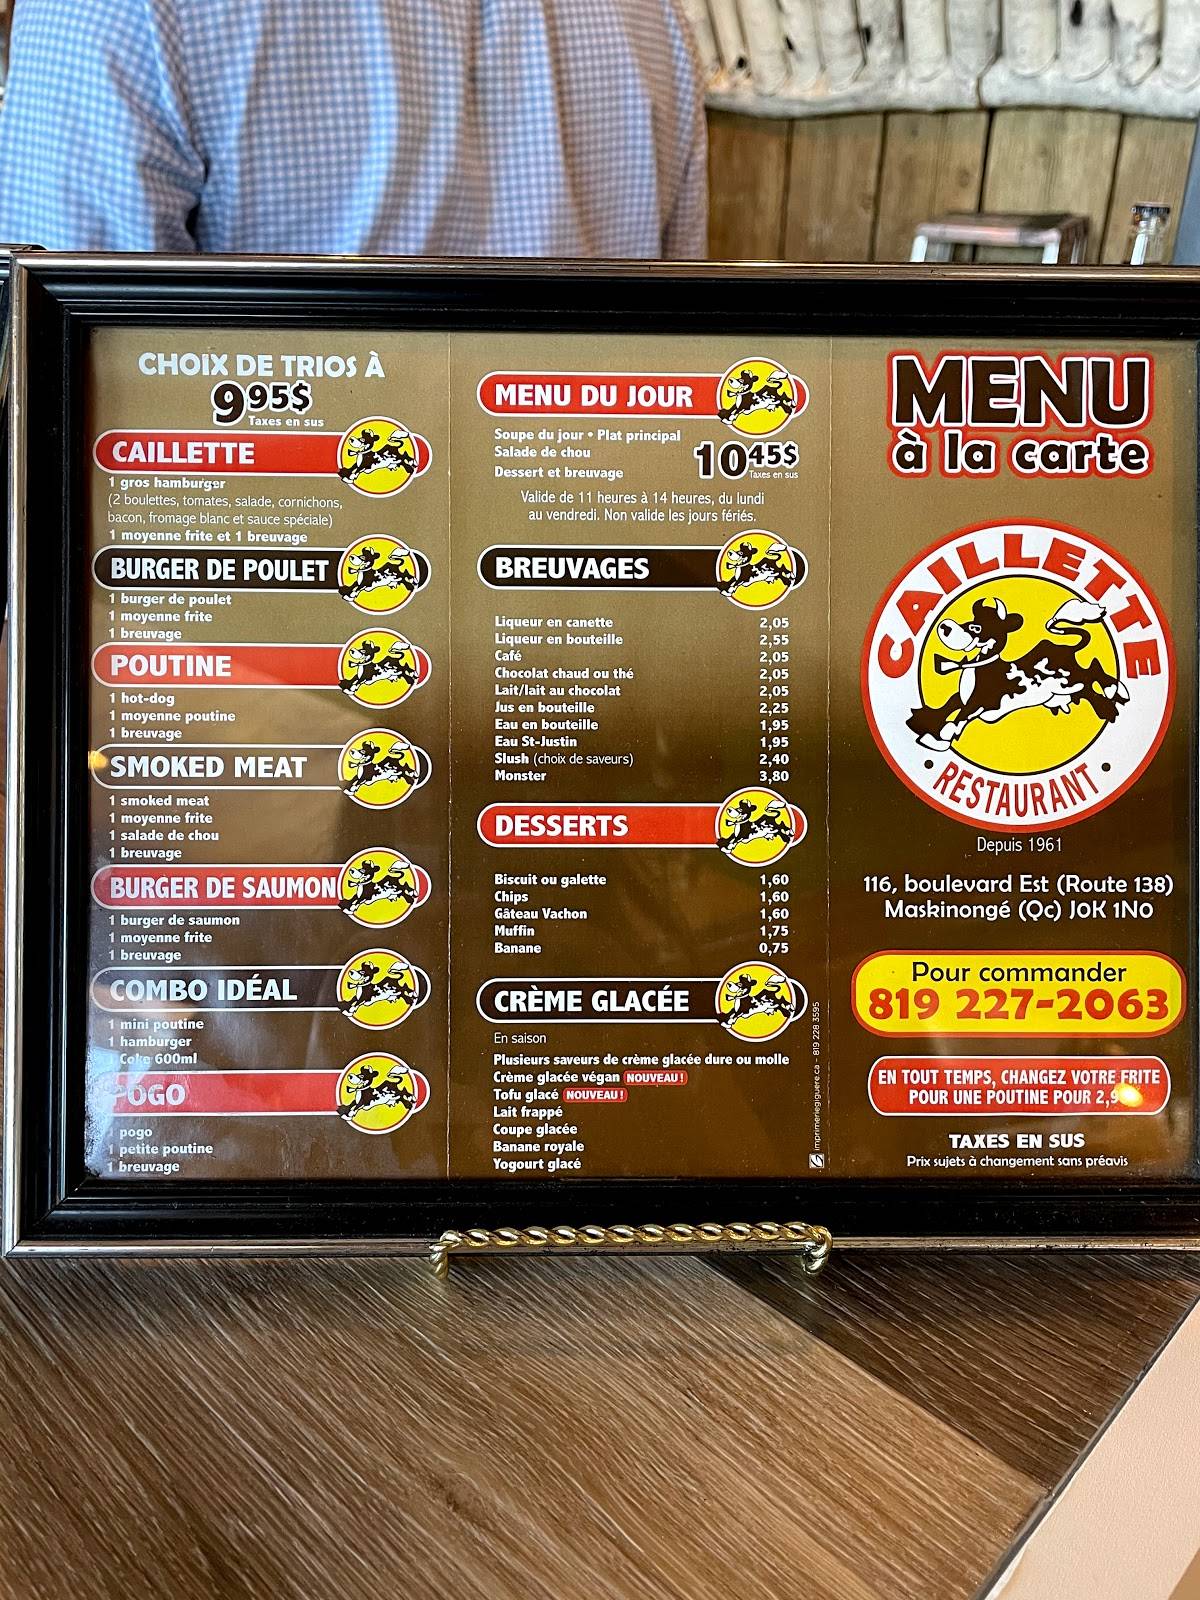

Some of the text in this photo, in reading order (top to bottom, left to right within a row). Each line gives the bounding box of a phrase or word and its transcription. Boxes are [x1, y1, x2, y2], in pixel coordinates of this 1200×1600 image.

[138, 351, 385, 378] CHOIX DE TRIOS À
[496, 384, 693, 408] MENU DU JOUR
[894, 357, 1150, 427] MENU
[494, 429, 681, 443] Soupe du jour Plat principal
[112, 441, 254, 464] CAILLETTE
[893, 429, 1149, 473] à la carte
[749, 470, 770, 479] Taxes
[109, 478, 225, 490] 1 gros hamburger
[108, 493, 343, 510] (2 boulettes, tomates, salade, cornichons,
[521, 490, 764, 506] Valide de 11 heures à 14 heures, du lundi
[108, 511, 333, 528] bacon, fromage blanc et sauce spéciale)
[529, 508, 756, 524] au vendredi. Non valide les jours fériés.
[111, 558, 329, 581] BURGER DE POULET
[496, 557, 649, 579] BREUVAGES
[878, 534, 1160, 679] CAILLETTE
[495, 616, 789, 630] Liqueur en canette 2,05
[111, 655, 231, 677] POUTINE
[495, 651, 789, 664] Café 2,05
[109, 693, 175, 706] 1 hot-dog
[495, 685, 789, 699] Lait/lait au chocolat 2,05
[495, 736, 789, 749] Eau St-Justin 1,95
[110, 756, 307, 778] SMOKED MEAT
[495, 753, 789, 767] Slush (choix de saveurs) 2,40
[495, 770, 789, 783] Monster 3,80
[933, 761, 1099, 817] RESTAURANT
[496, 815, 628, 836] DESSERTS
[977, 836, 1062, 856] Depuis 1961
[111, 877, 336, 899] BURGER DE SAUMON
[495, 874, 789, 888] Biscuit ou galette 1,60
[864, 875, 1174, 895] 116, boulevard Est (Route 138)
[495, 892, 789, 904] Chips 1,60
[885, 900, 1010, 922] Maskinongé
[1018, 901, 1061, 923] (Qc)
[495, 926, 788, 938] Muffin 1,75
[495, 943, 788, 955] Banane 0,75
[912, 961, 1127, 983] Pour commander
[110, 974, 298, 1001] COMBO IDÉAL
[495, 985, 689, 1012] CRÈME GLACÉE
[869, 988, 1168, 1020] 819 227-2063
[494, 1032, 546, 1043] En saison
[493, 1054, 789, 1067] Plusieurs saveurs de crème glacée dure ou molle
[878, 1070, 1160, 1088] EN TOUT TEMPS, CHANGEZ VOTRE FRITE
[493, 1106, 562, 1120] Lait frappé
[949, 1134, 1084, 1149] TAXES EN SUS
[493, 1158, 581, 1172] Yogourt glacé
[907, 1156, 1128, 1169] Prix sujets à changement sans préavis
